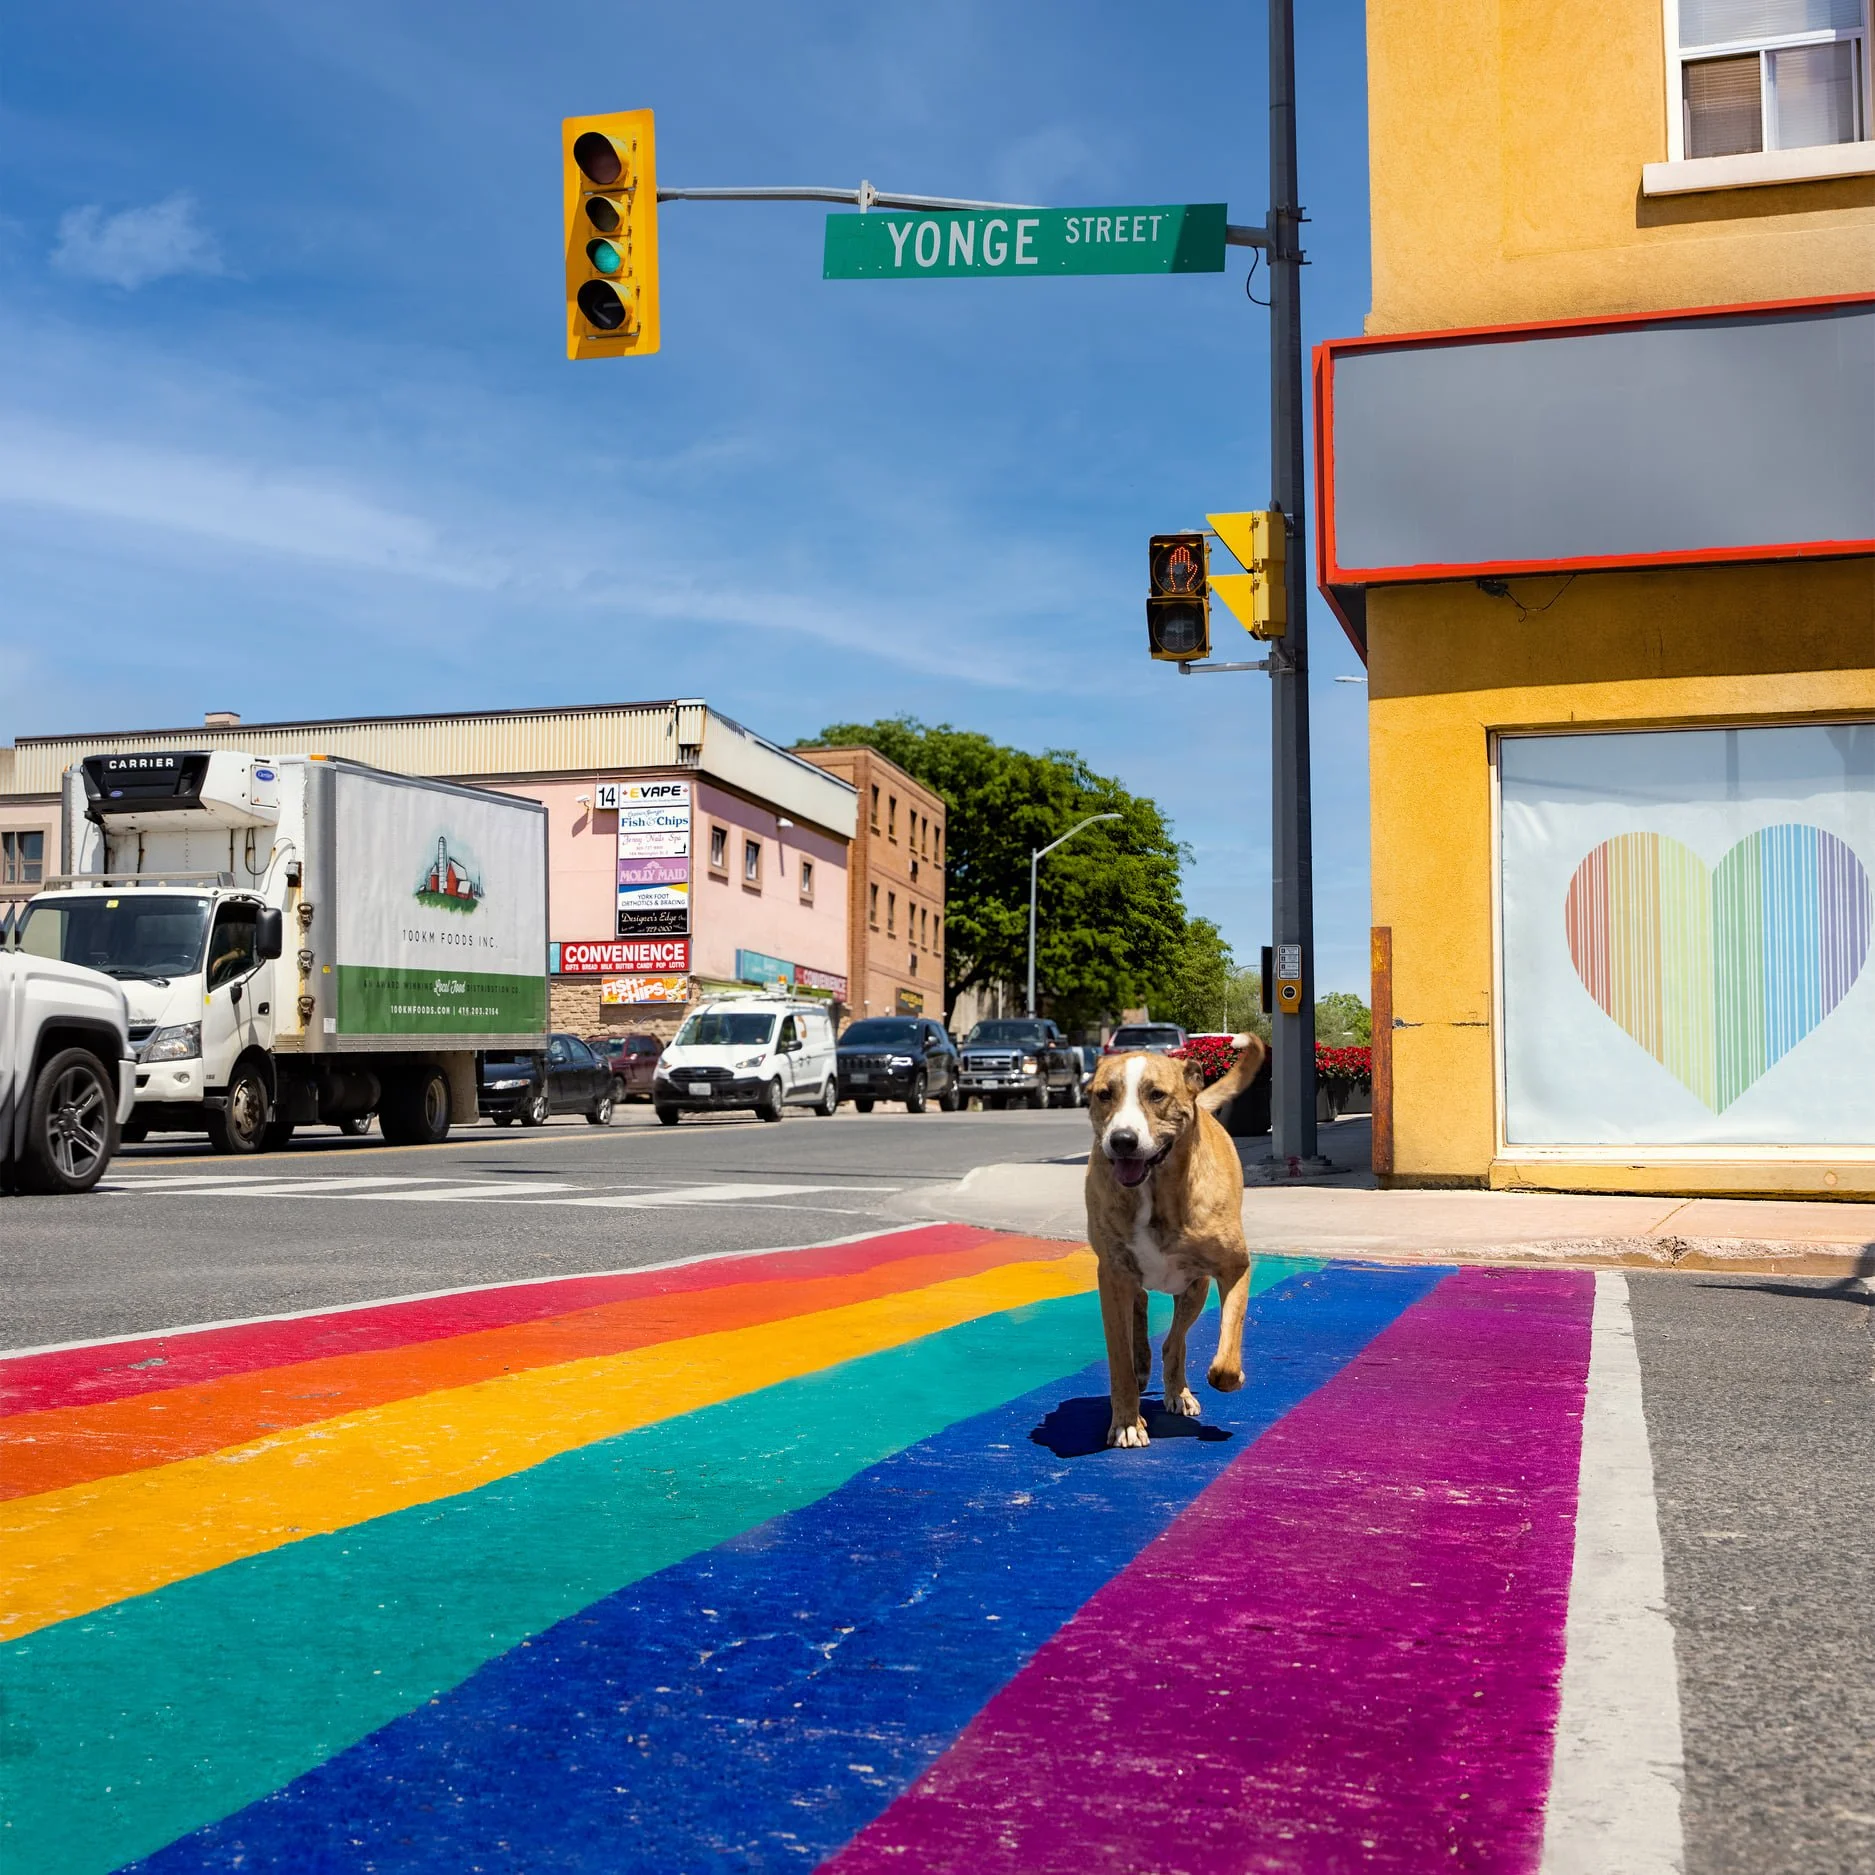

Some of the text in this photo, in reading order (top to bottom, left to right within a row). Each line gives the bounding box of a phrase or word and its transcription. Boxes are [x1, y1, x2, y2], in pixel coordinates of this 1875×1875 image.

[887, 215, 1163, 267] YONGE STREET
[109, 757, 174, 769] CARRIER
[598, 787, 616, 806] 14
[621, 817, 645, 827] Fish
[656, 816, 688, 827] Chips
[620, 868, 687, 882] MOLLY MAID
[659, 911, 677, 924] Edge
[402, 929, 498, 948] 100KM FOODS INC.
[565, 943, 685, 963] CONVENIENCE
[616, 962, 634, 970] BUTTER
[669, 961, 685, 969] LOTTO
[618, 982, 665, 1003] CHIPS
